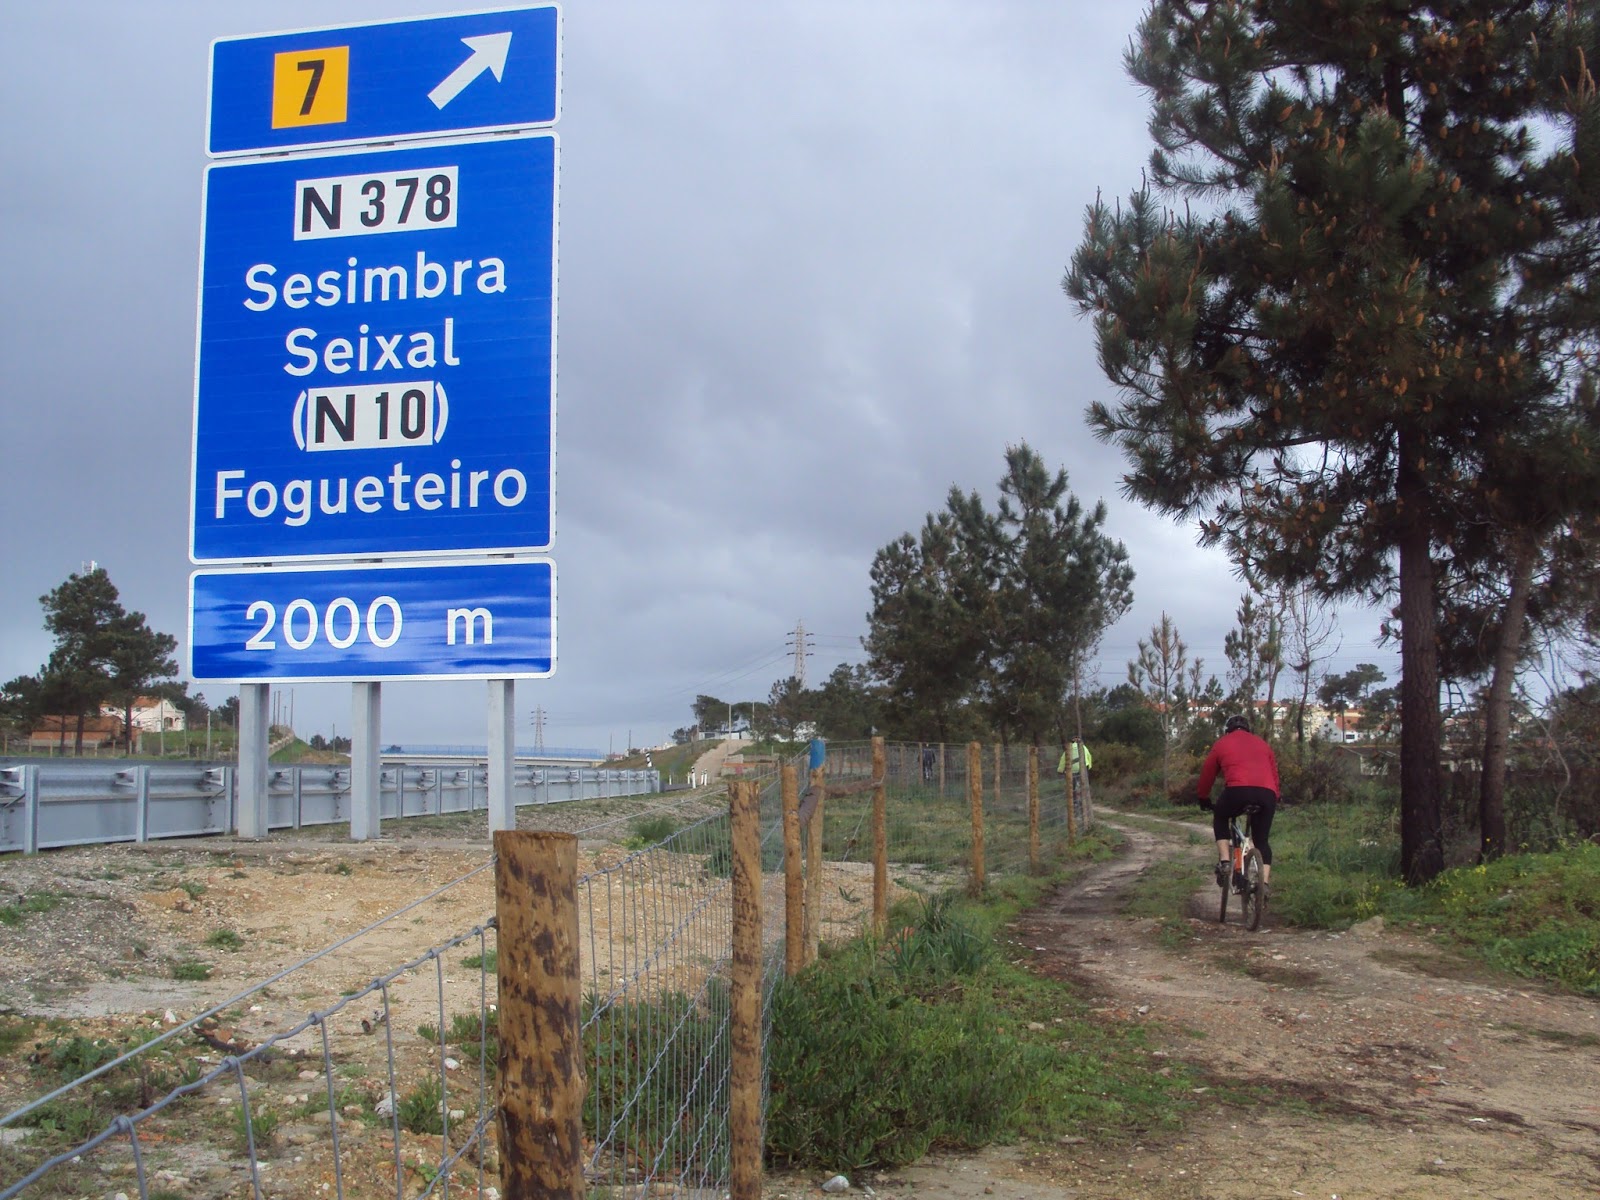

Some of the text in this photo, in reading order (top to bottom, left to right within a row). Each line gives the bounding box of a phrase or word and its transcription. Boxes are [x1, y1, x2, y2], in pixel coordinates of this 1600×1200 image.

[297, 59, 325, 116] 7
[301, 174, 451, 233] N 378
[243, 251, 507, 312] Sesimbra
[283, 317, 460, 377] Seixal
[214, 459, 527, 527] Fogueteiro
[245, 596, 493, 651] 2000 m
